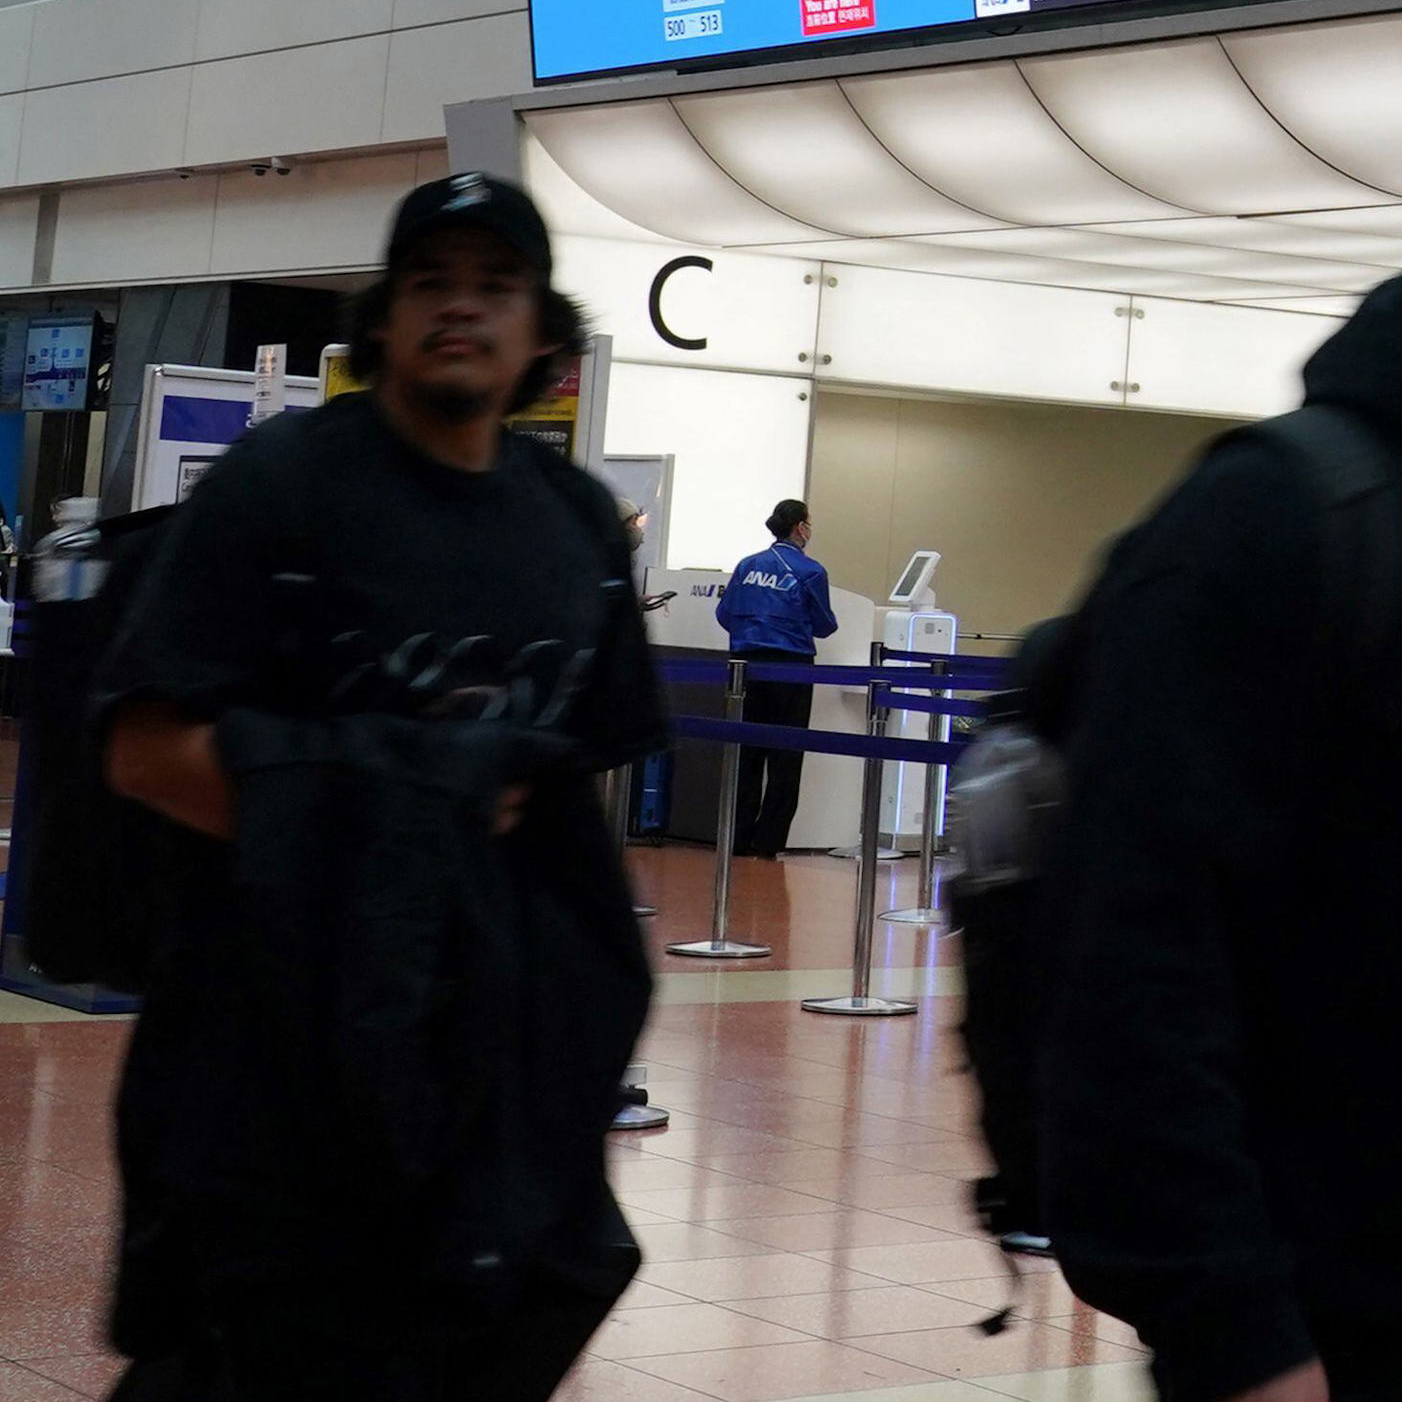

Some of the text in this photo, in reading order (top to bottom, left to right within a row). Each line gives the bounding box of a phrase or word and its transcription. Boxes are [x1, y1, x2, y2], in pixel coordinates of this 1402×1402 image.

[699, 14, 720, 33] 513
[649, 255, 714, 351] C
[742, 570, 780, 589] ANA
